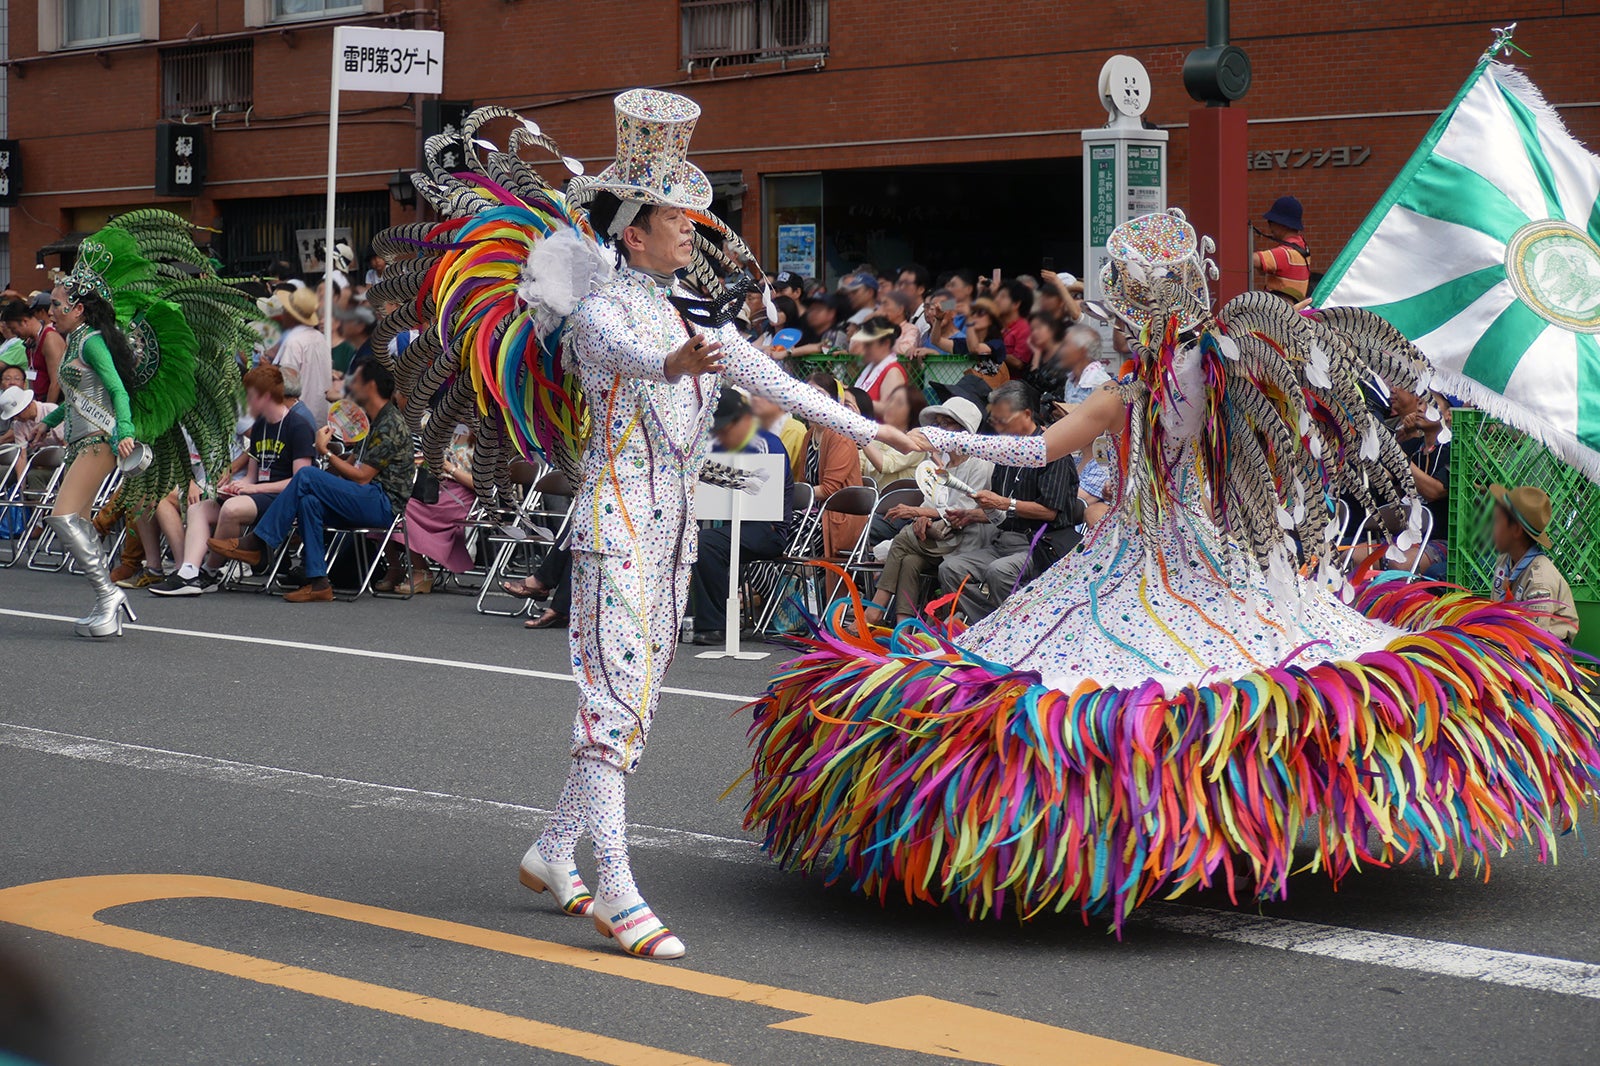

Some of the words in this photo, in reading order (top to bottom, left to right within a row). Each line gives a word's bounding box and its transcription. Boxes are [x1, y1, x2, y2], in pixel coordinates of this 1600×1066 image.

[343, 45, 439, 76] 雷門第3ゲート
